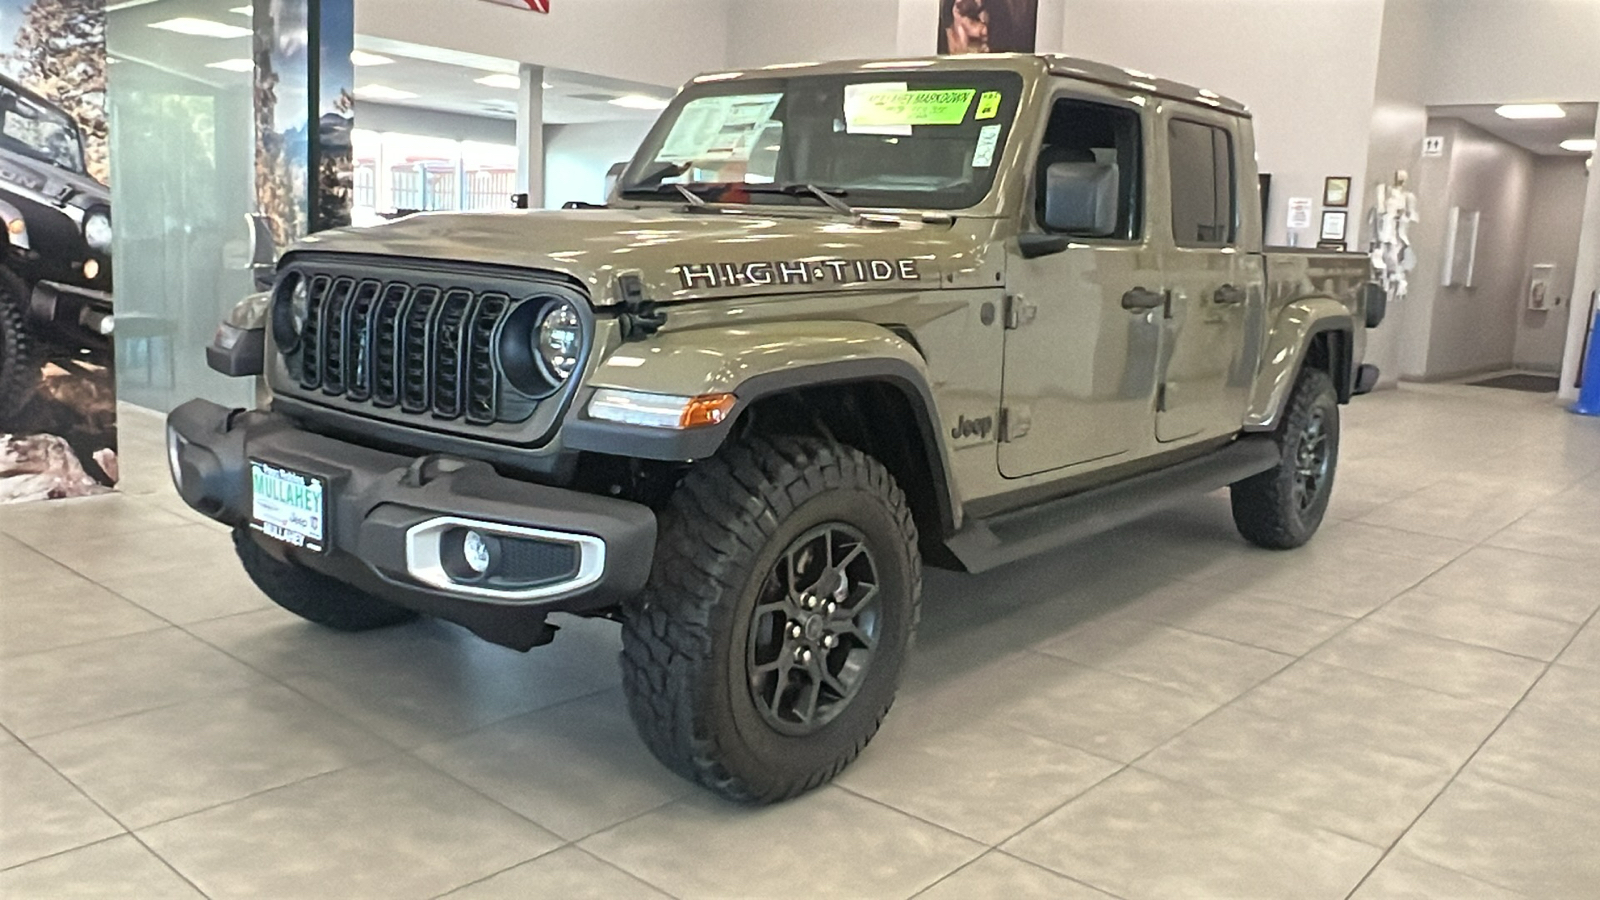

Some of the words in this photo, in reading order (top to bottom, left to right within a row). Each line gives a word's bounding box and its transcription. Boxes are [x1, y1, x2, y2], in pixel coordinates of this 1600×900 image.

[682, 262, 812, 288] HIGH
[822, 259, 920, 281] TIDE
[951, 414, 992, 439] Jeep
[253, 472, 321, 513] MULLAHEY
